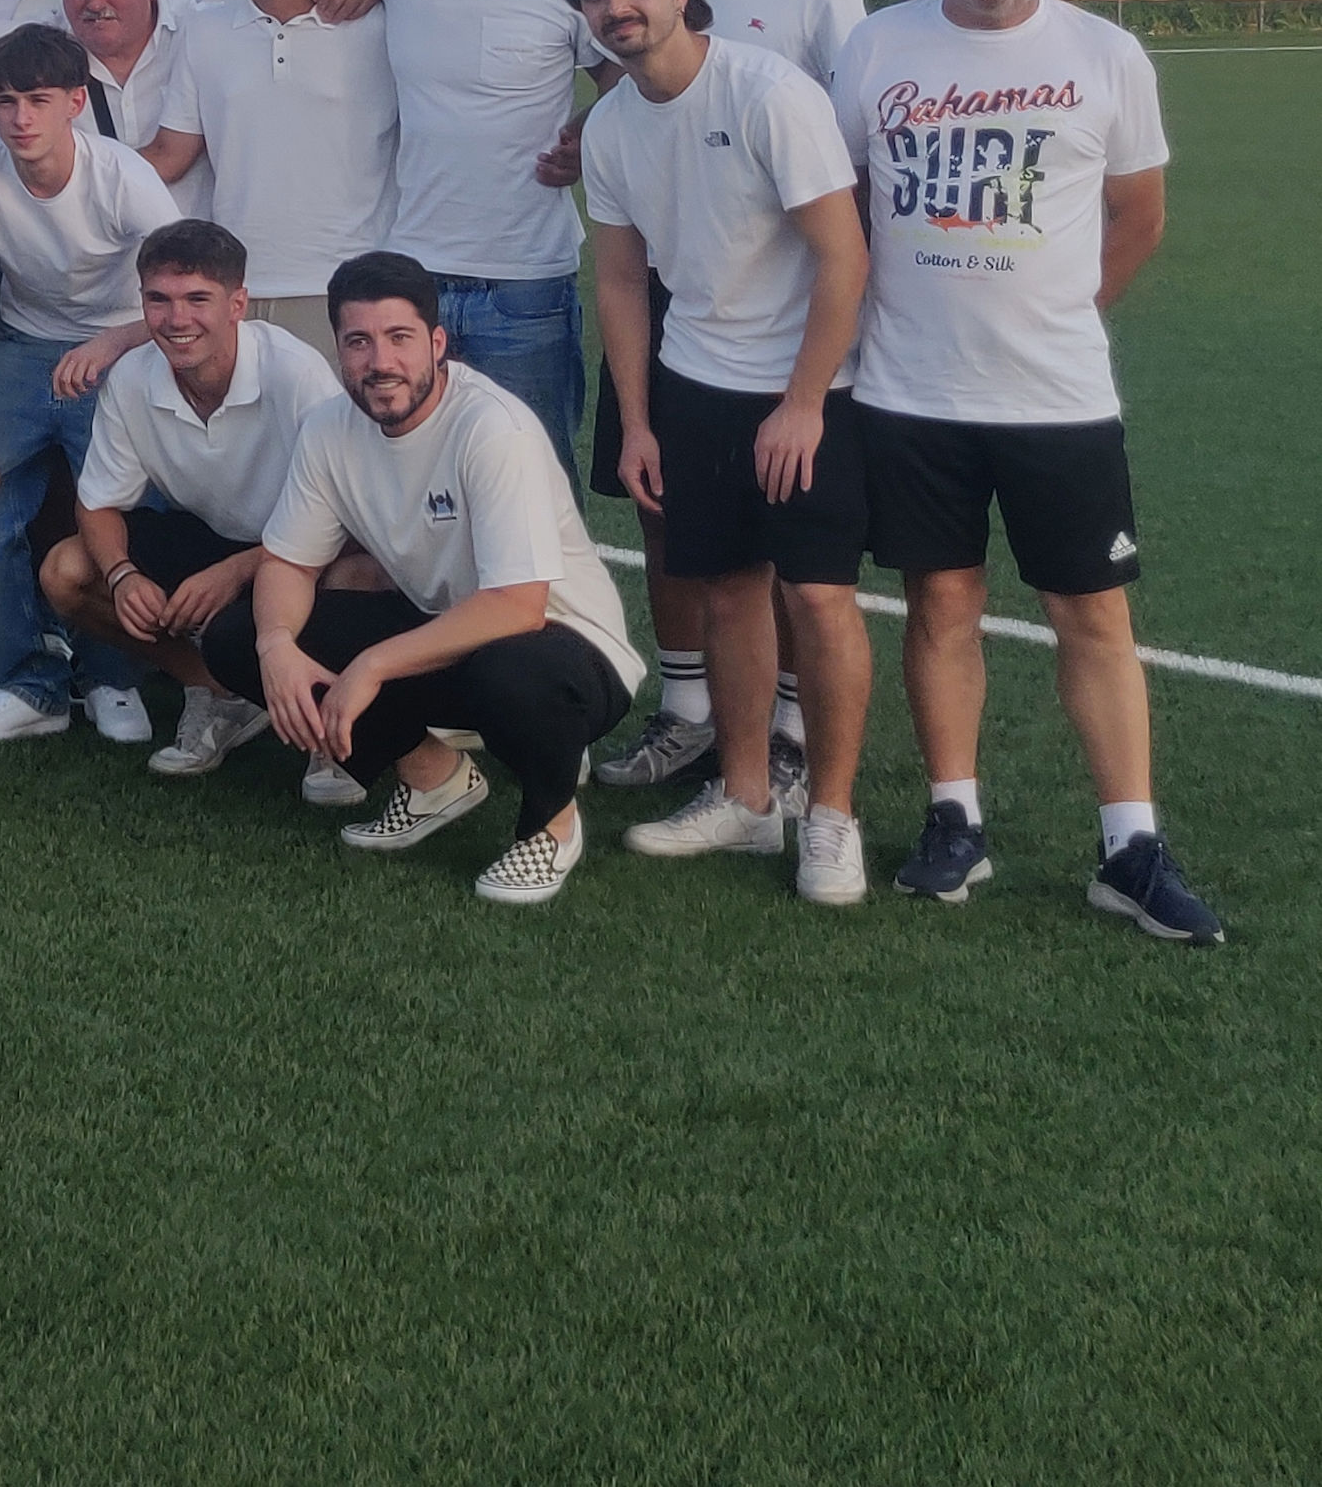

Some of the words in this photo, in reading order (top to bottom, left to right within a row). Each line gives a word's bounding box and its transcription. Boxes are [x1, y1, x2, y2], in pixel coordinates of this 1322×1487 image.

[877, 80, 1084, 133] Bahamas
[915, 250, 962, 268] Cotton
[967, 255, 979, 269] &
[984, 255, 1015, 271] Silk
